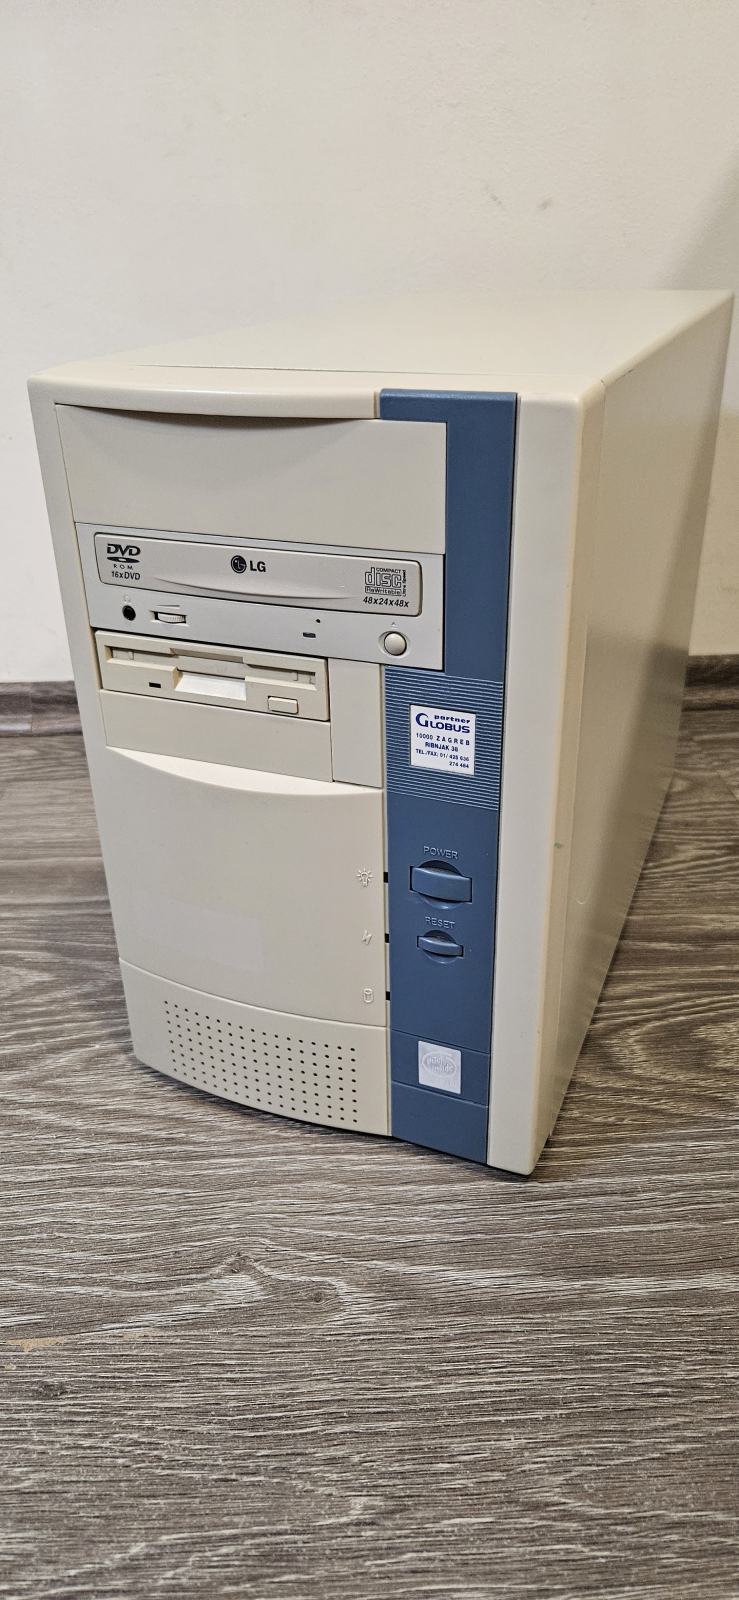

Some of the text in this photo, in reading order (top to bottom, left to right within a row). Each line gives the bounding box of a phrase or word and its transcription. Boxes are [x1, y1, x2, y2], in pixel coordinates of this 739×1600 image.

[107, 543, 141, 557] DVD
[249, 561, 267, 573] LG
[111, 571, 141, 581] 16xDVD
[363, 596, 410, 608] 48x24x48x
[415, 712, 471, 734] GLOBUS
[434, 714, 471, 724] partner
[416, 732, 434, 741] 10000
[425, 741, 450, 751] RIBNJAK
[423, 845, 459, 860] POWER
[425, 916, 456, 929] RESET
